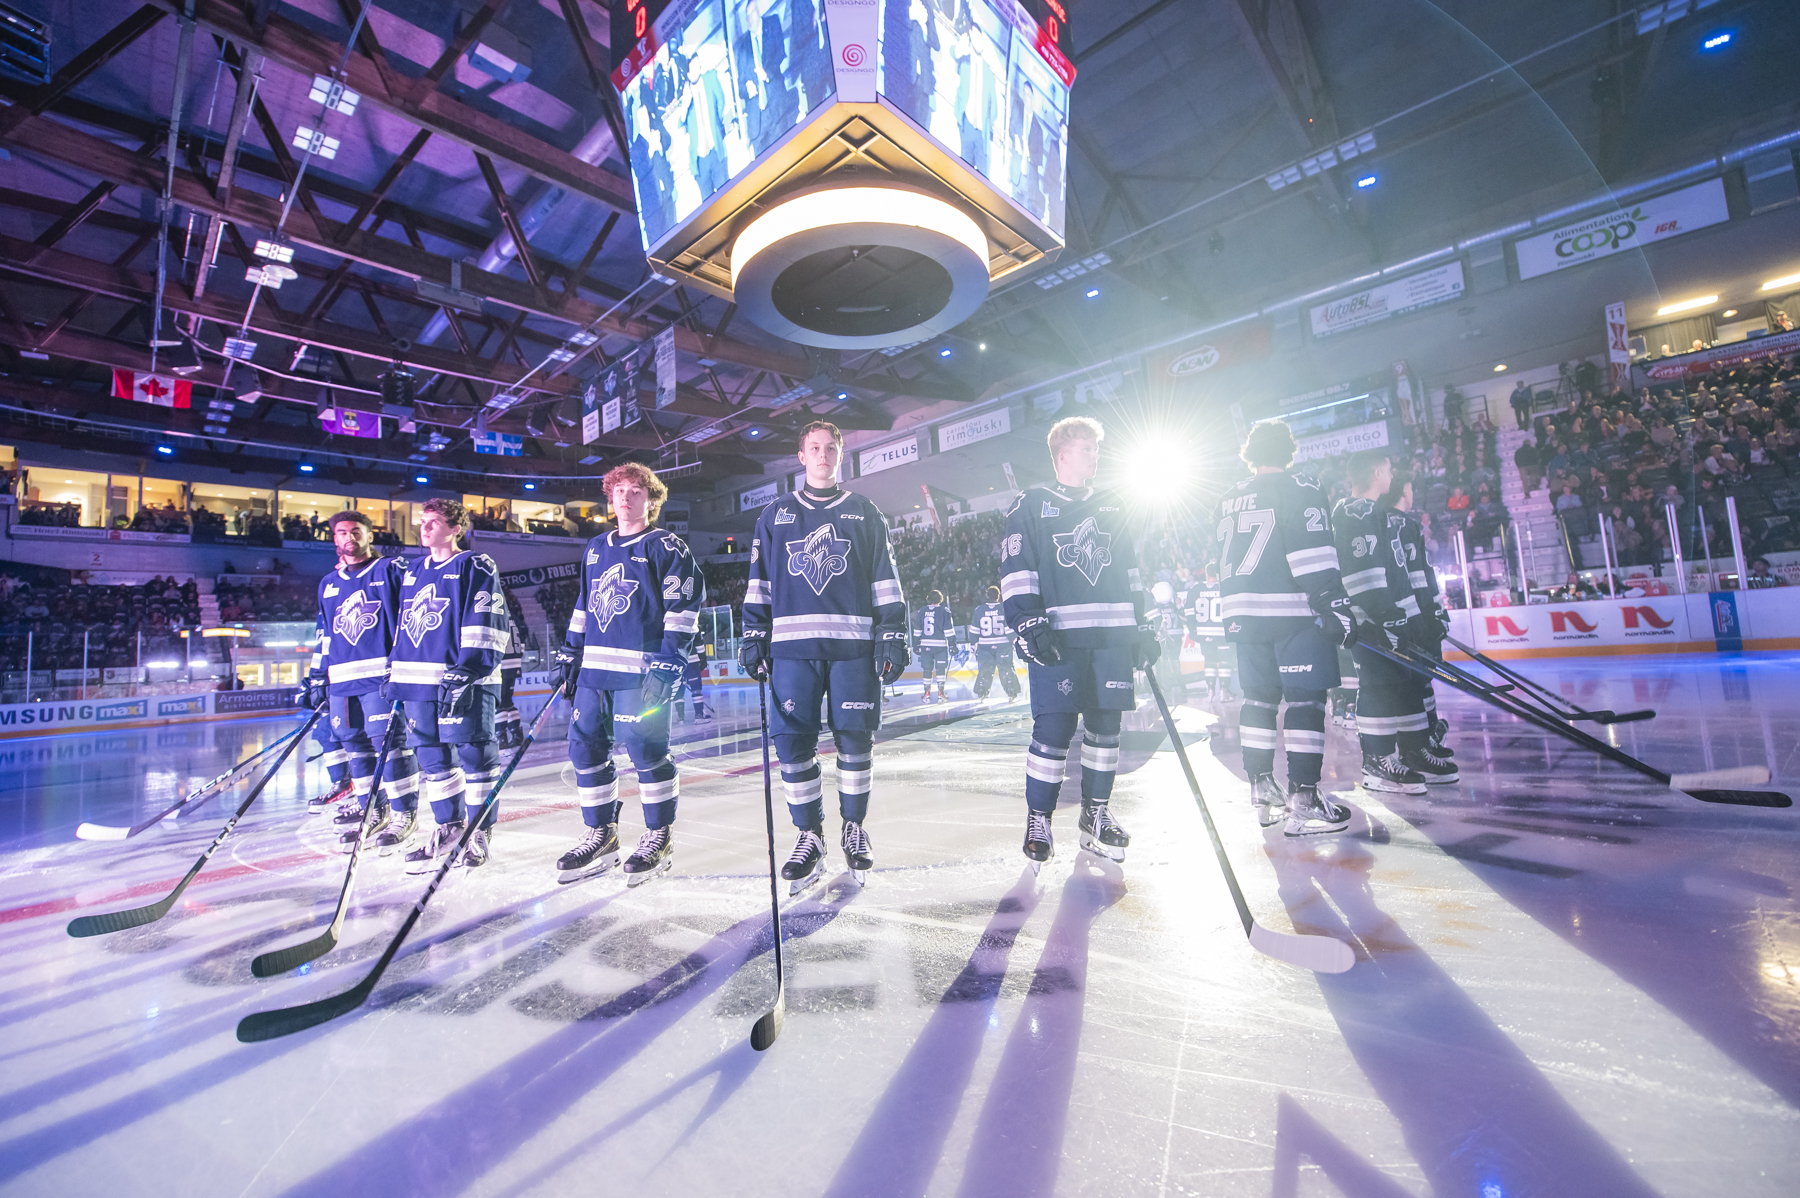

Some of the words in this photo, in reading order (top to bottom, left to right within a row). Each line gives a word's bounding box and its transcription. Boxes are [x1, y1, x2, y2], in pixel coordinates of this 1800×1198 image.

[635, 6, 647, 38] 0
[1047, 15, 1059, 43] 0
[1553, 211, 1630, 241] Alimentation
[1654, 220, 1678, 234] IGA
[1555, 220, 1636, 257] coop
[1557, 252, 1595, 267] Rimouski
[1409, 278, 1438, 291] Location
[1176, 352, 1216, 374] A&W
[946, 420, 982, 436] carrefour
[946, 419, 1003, 443] rimouski
[1299, 438, 1340, 454] PHYSIO
[1347, 430, 1382, 445] ERGO
[882, 444, 917, 462] TELUS
[750, 492, 779, 507] Fairstone
[1221, 493, 1258, 517] PILOTE
[1216, 508, 1276, 582] 27
[1351, 534, 1378, 558] 37
[1404, 542, 1417, 561] 7
[500, 574, 527, 587] STRO
[547, 563, 578, 579] FORGE
[663, 575, 695, 600] 24
[474, 590, 505, 615] 22
[1195, 597, 1224, 622] 90
[1330, 597, 1351, 608] CC
[923, 616, 935, 636] 6
[979, 615, 1005, 637] 95
[1017, 616, 1050, 633] CCM
[1138, 624, 1156, 632] CC
[1382, 618, 1405, 628] CC
[1625, 629, 1675, 637] normandin
[650, 661, 684, 673] CCM
[1278, 664, 1313, 673] CCM
[516, 676, 550, 685] TELU
[100, 702, 145, 718] maxi
[161, 697, 204, 714] maxi
[218, 693, 276, 704] Armoires
[224, 701, 276, 710] DISTINCTION
[841, 701, 875, 710] CCM
[614, 713, 643, 723] CCM
[185, 768, 234, 802] CCM
